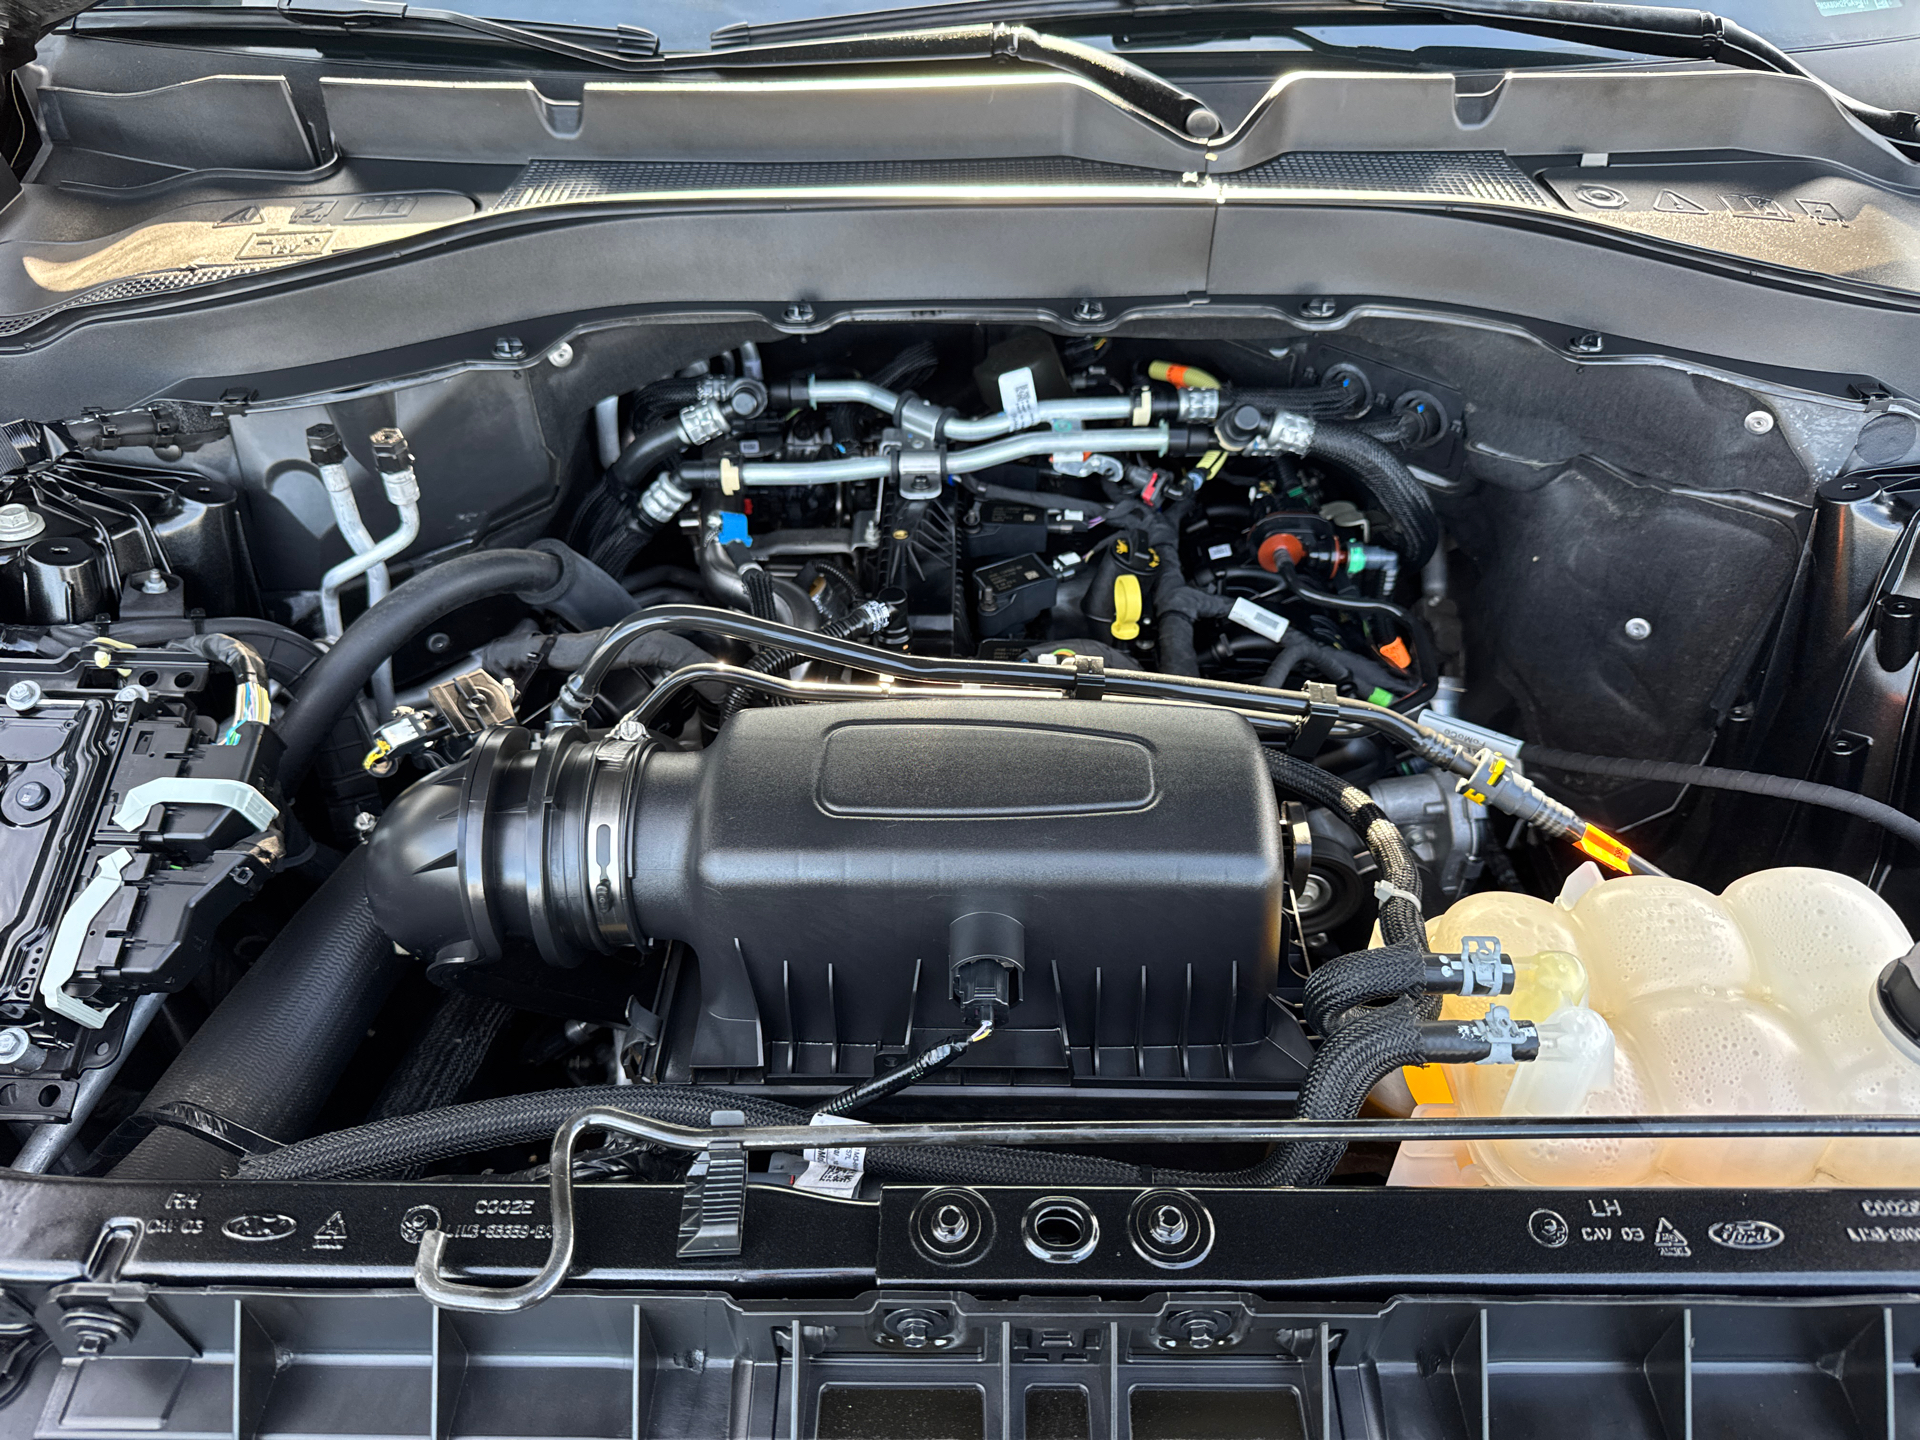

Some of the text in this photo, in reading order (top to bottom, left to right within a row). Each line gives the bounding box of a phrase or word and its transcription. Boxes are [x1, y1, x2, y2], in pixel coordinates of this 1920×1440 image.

[1443, 728, 1487, 748] FoMoCo
[1587, 1199, 1622, 1217] LH
[1620, 1227, 1646, 1242] 03
[1718, 1221, 1776, 1246] Ford
